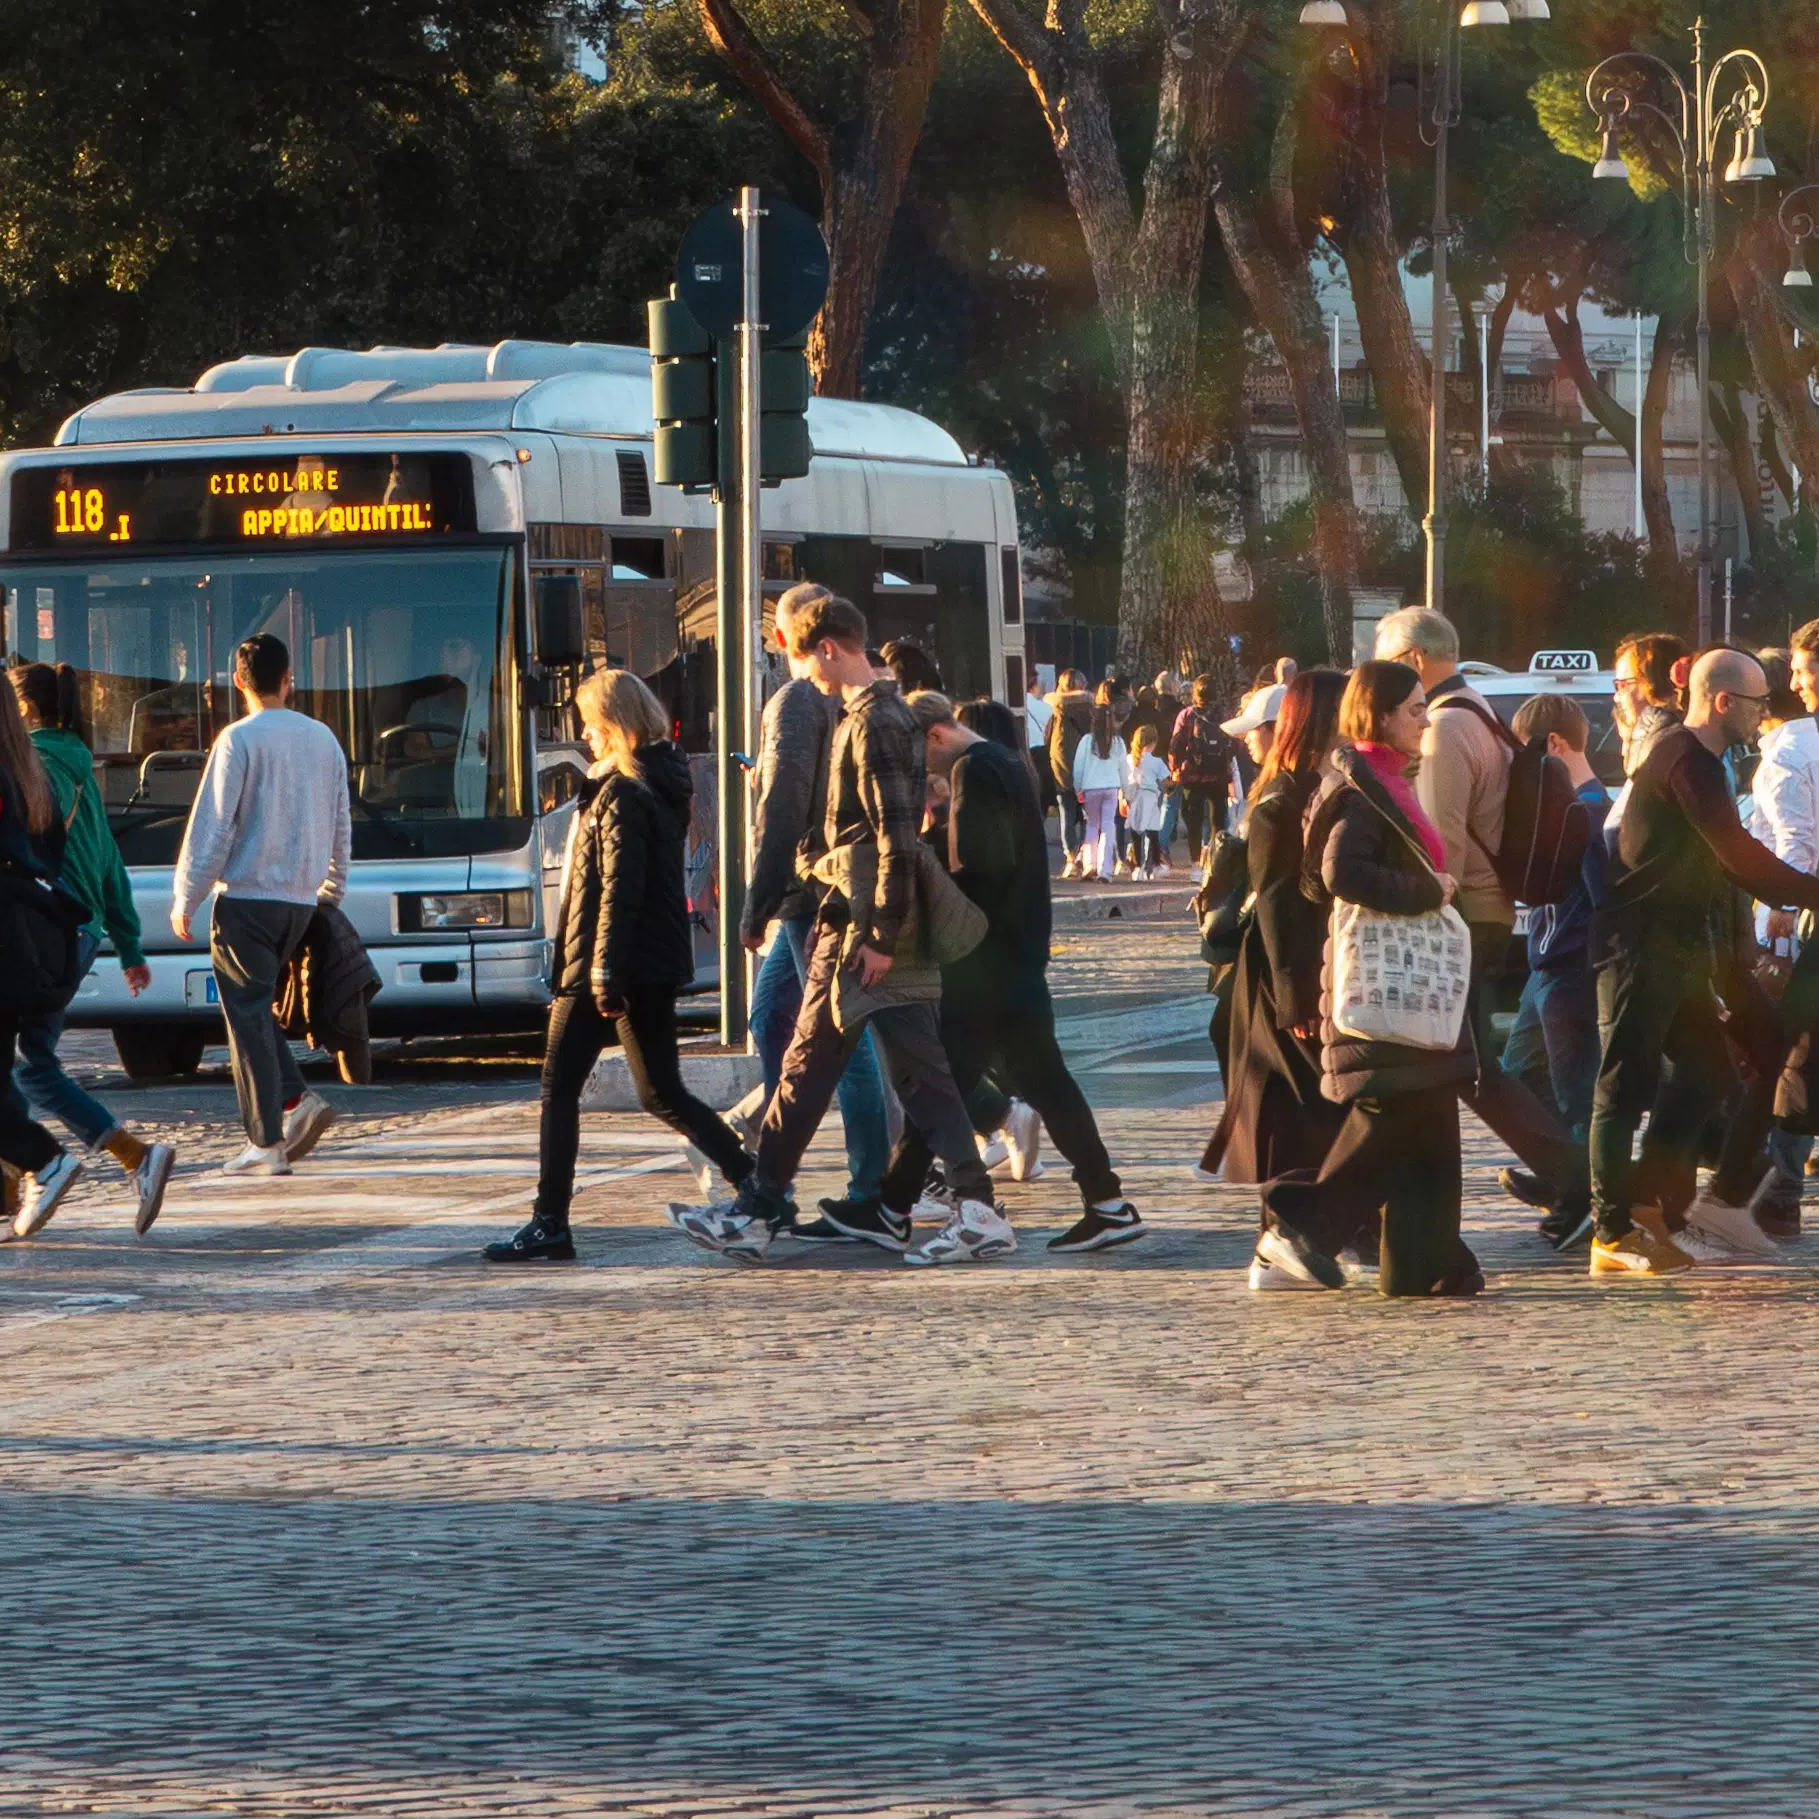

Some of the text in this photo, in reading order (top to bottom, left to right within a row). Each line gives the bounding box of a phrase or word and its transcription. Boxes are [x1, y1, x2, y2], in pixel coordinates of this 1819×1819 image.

[210, 469, 340, 495] CIRCOLARE
[54, 488, 105, 533] 118
[1539, 655, 1588, 668] TAXI
